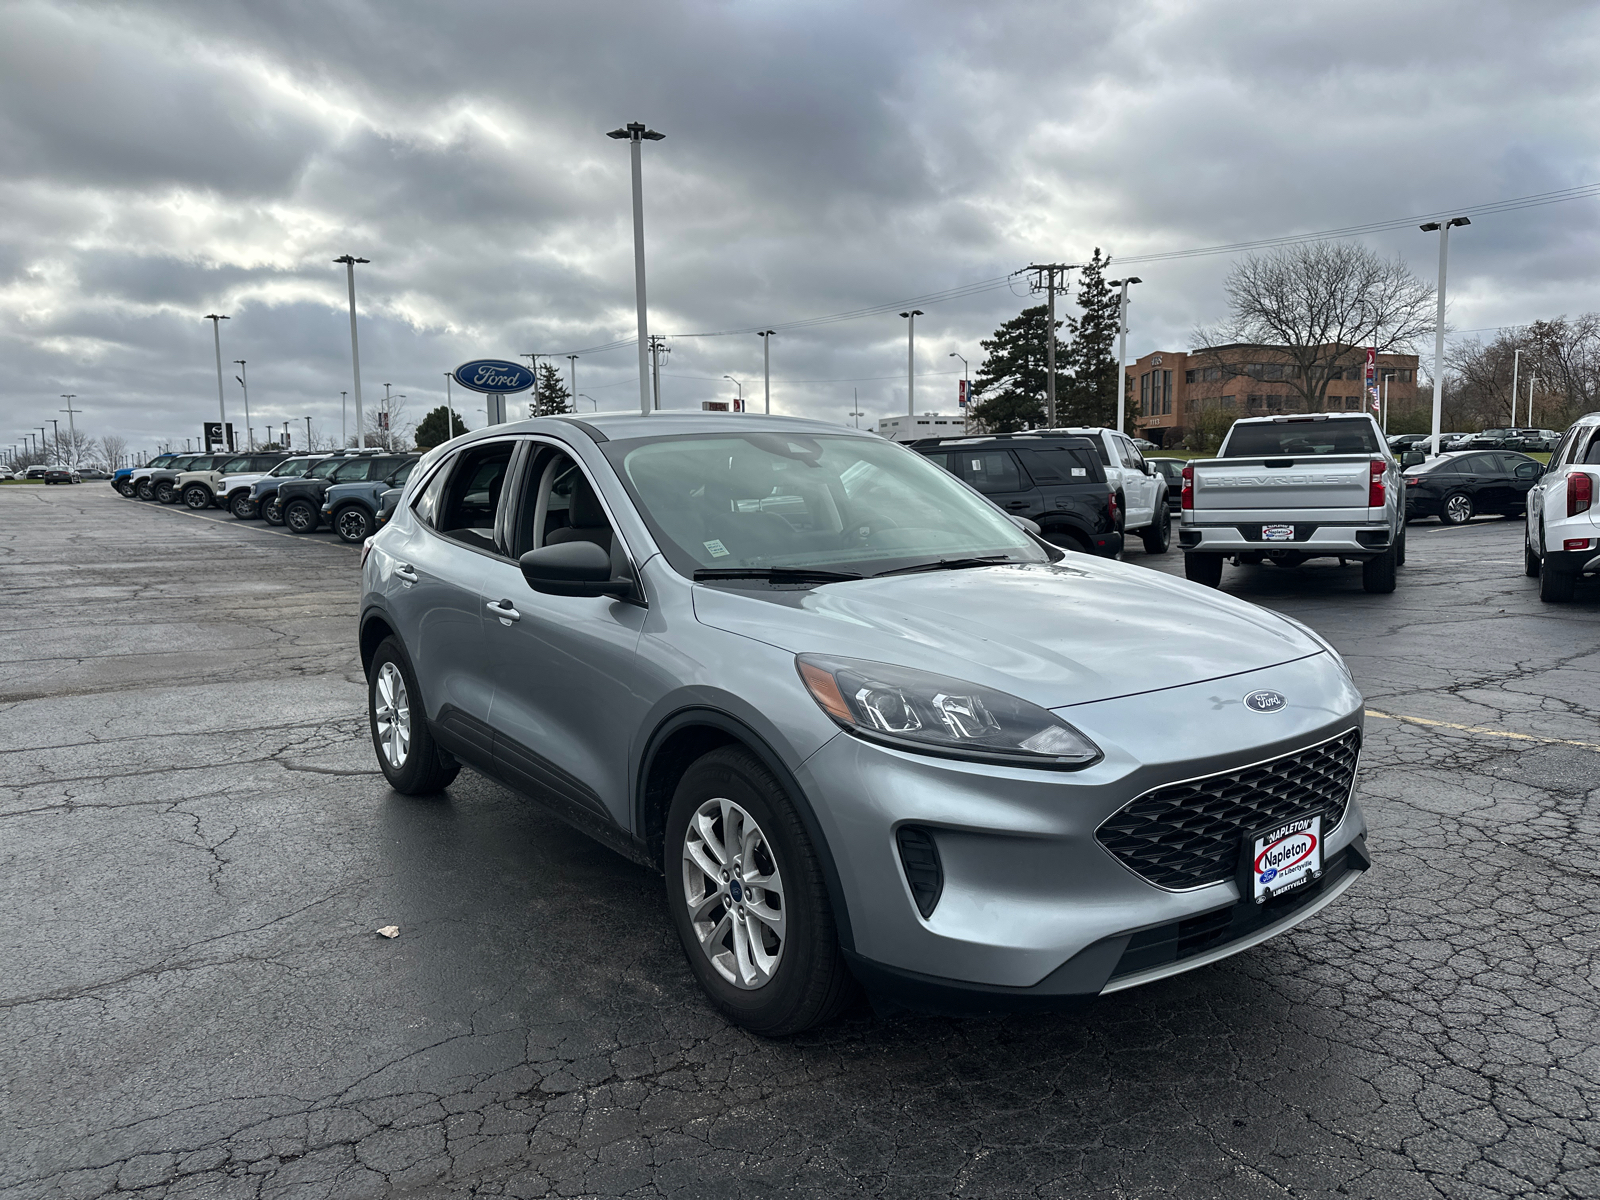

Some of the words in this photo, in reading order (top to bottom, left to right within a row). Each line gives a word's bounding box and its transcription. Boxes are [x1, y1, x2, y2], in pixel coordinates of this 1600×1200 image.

[473, 365, 520, 387] Ford
[1204, 474, 1357, 487] CHEVROLET
[1255, 693, 1281, 709] Ford
[1269, 819, 1309, 843] NAPLETON
[1264, 842, 1307, 869] Napleton
[1262, 870, 1275, 882] Ford
[1278, 871, 1284, 879] in
[1284, 860, 1312, 876] Libertyville
[1272, 877, 1307, 897] LIBERTYVILLE
